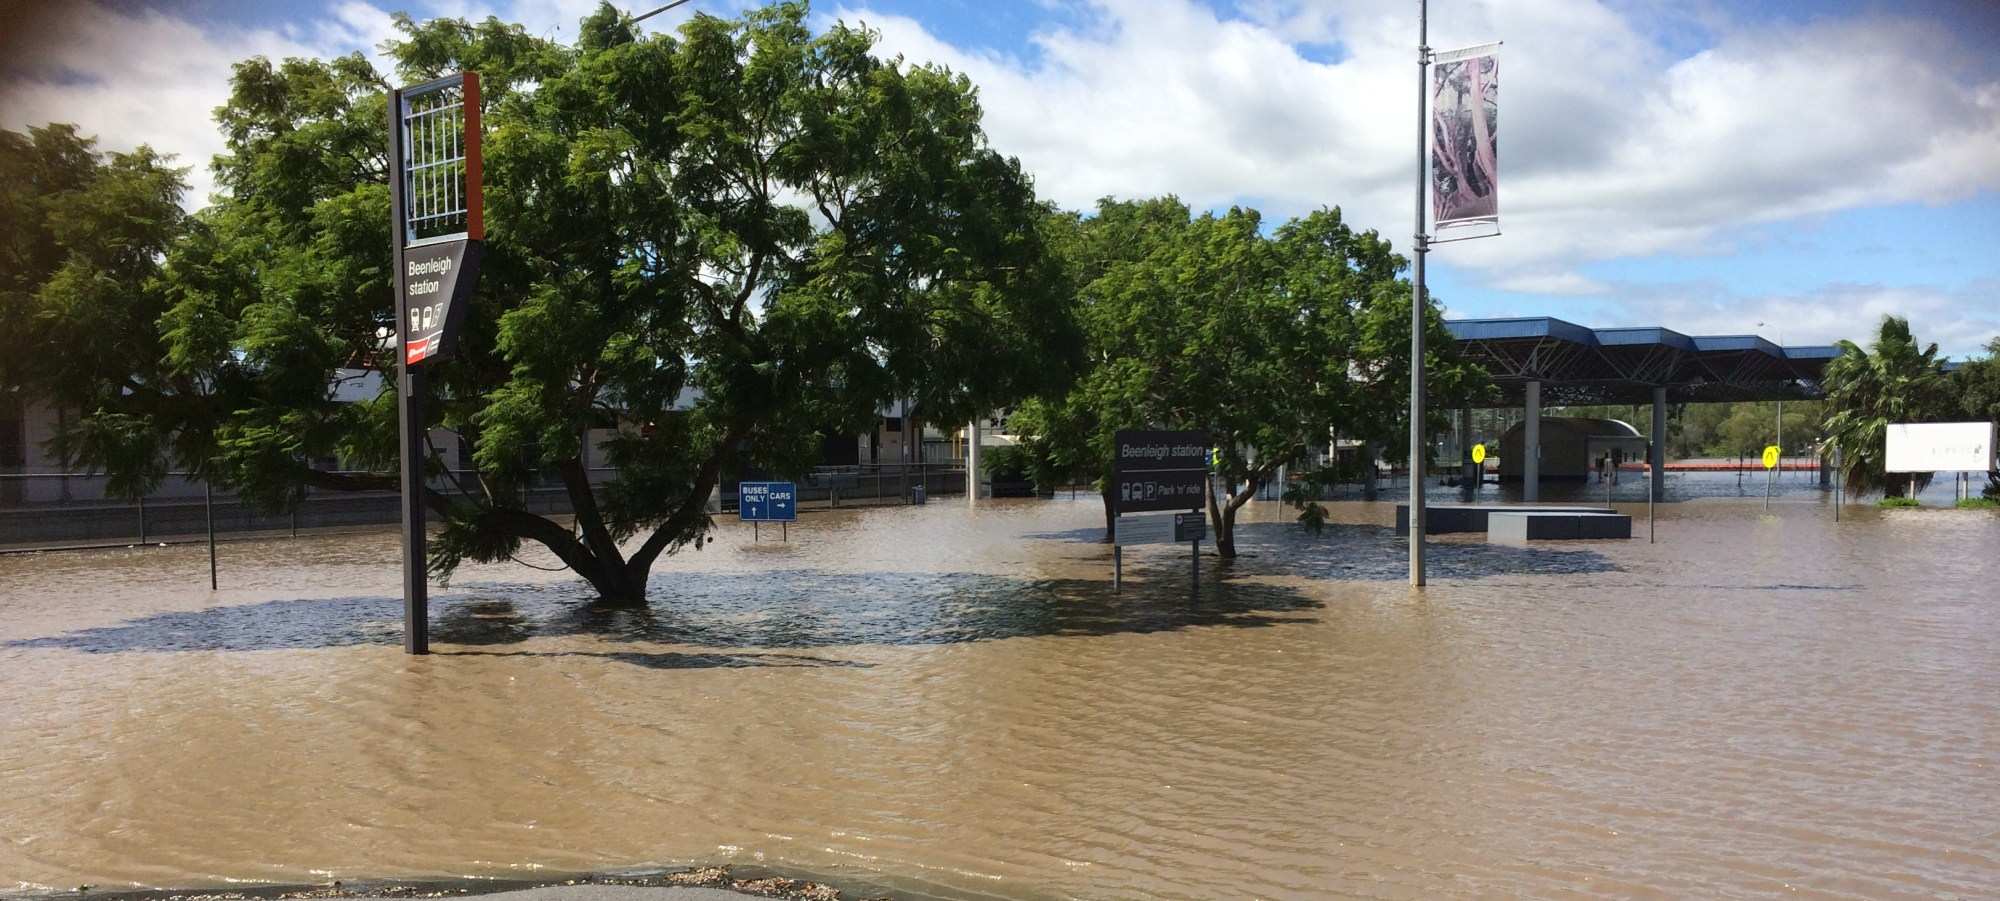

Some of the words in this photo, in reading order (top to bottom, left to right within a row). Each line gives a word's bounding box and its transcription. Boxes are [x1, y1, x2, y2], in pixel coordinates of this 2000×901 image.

[408, 256, 452, 275] Beenleigh
[409, 279, 439, 296] station
[1121, 444, 1169, 460] Beenleigh
[1171, 444, 1203, 457] station
[770, 492, 791, 500] CARS
[1158, 485, 1175, 495] Park
[1186, 483, 1201, 494] ride
[745, 495, 765, 503] ONLY
